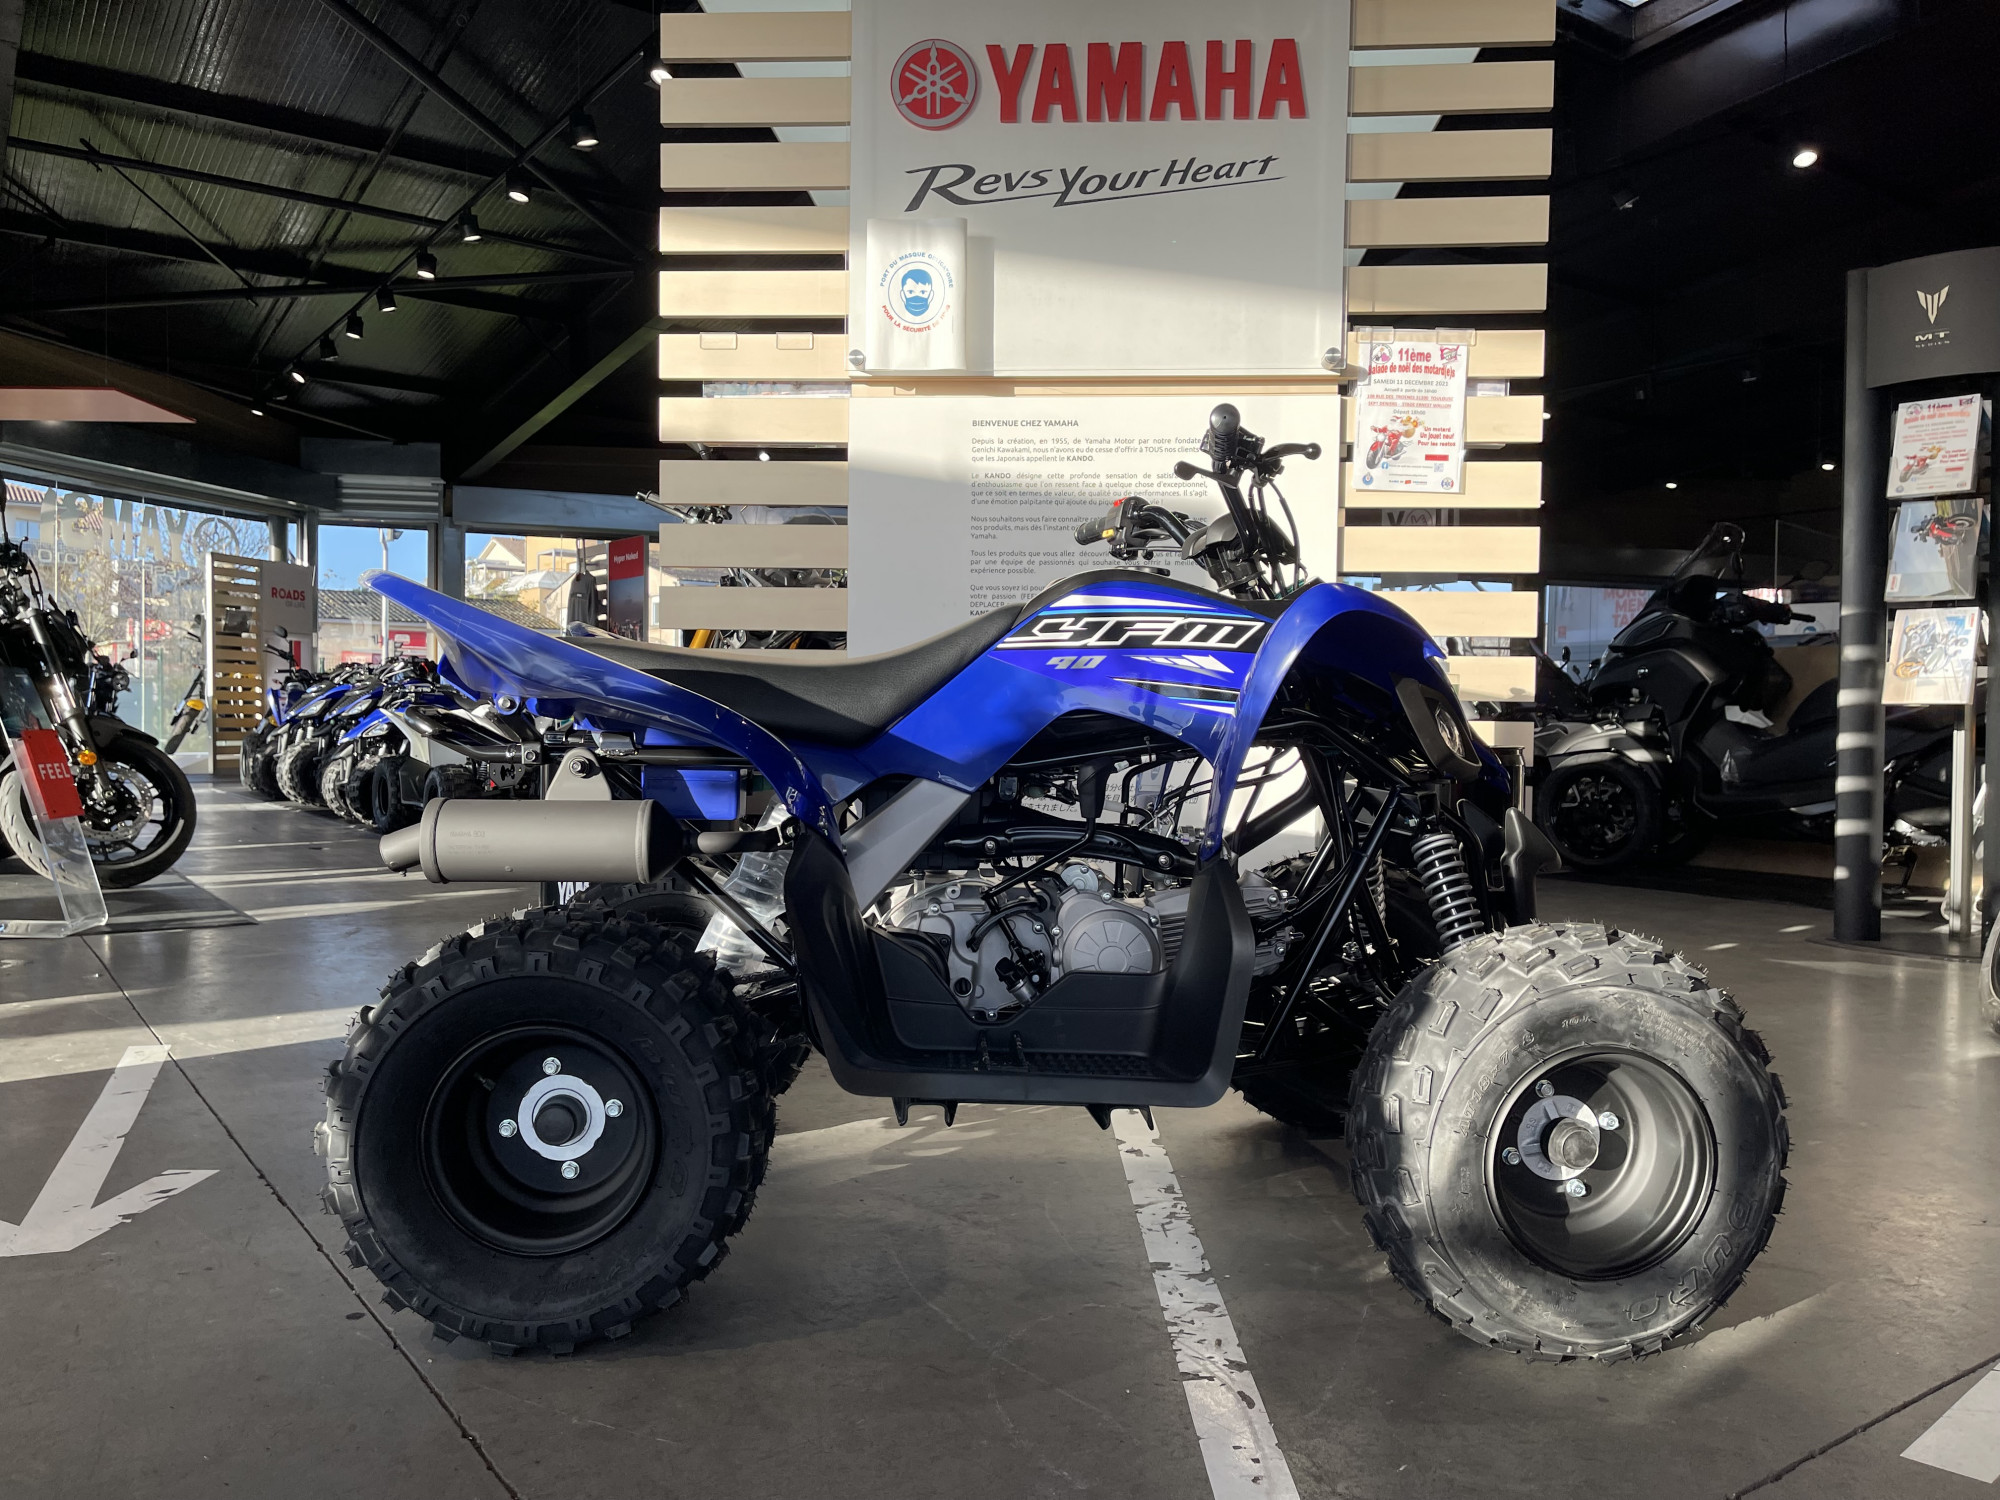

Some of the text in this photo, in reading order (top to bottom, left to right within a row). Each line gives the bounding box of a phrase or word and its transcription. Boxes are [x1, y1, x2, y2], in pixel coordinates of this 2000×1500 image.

[986, 39, 1307, 123] YAMAHA
[904, 155, 1281, 212] Revs Your Heart
[880, 252, 954, 288] PORT DU MASQUE OIGATOIRE
[882, 304, 901, 328] POUR LA
[1915, 331, 1950, 342] MT
[1398, 348, 1432, 362] 11ème
[1390, 364, 1396, 373] de
[1398, 363, 1410, 373] noël
[1412, 363, 1422, 374] des
[972, 438, 994, 446] Depuis
[1007, 437, 1036, 446] création,
[1052, 438, 1069, 446] 1955,
[997, 446, 1031, 454] Kawakami,
[997, 455, 1025, 463] Japonais
[1026, 455, 1057, 463] appellent
[1016, 472, 1042, 481] désigne
[1070, 472, 1100, 481] profonde
[1025, 482, 1037, 490] que
[1106, 481, 1132, 490] quelque
[1157, 481, 1206, 490] d'exceptionnel,
[1054, 490, 1076, 498] valeur,
[1088, 490, 1110, 498] qualité
[1190, 490, 1207, 498] s'agit
[1020, 498, 1053, 506] palpitante
[1055, 498, 1064, 506] qui
[1065, 498, 1087, 506] ajoute
[984, 524, 1012, 532] produits,
[999, 550, 1026, 558] produits
[1001, 558, 1023, 567] équipe
[1039, 558, 1074, 567] passionnés
[1079, 558, 1088, 567] qui
[970, 567, 1037, 575] expérience possible.
[970, 584, 984, 593] Que
[1002, 585, 1020, 593] soyez
[271, 587, 306, 601] ROADS
[992, 593, 1016, 601] passion
[1046, 656, 1108, 670] 90
[38, 762, 70, 780] FEEL
